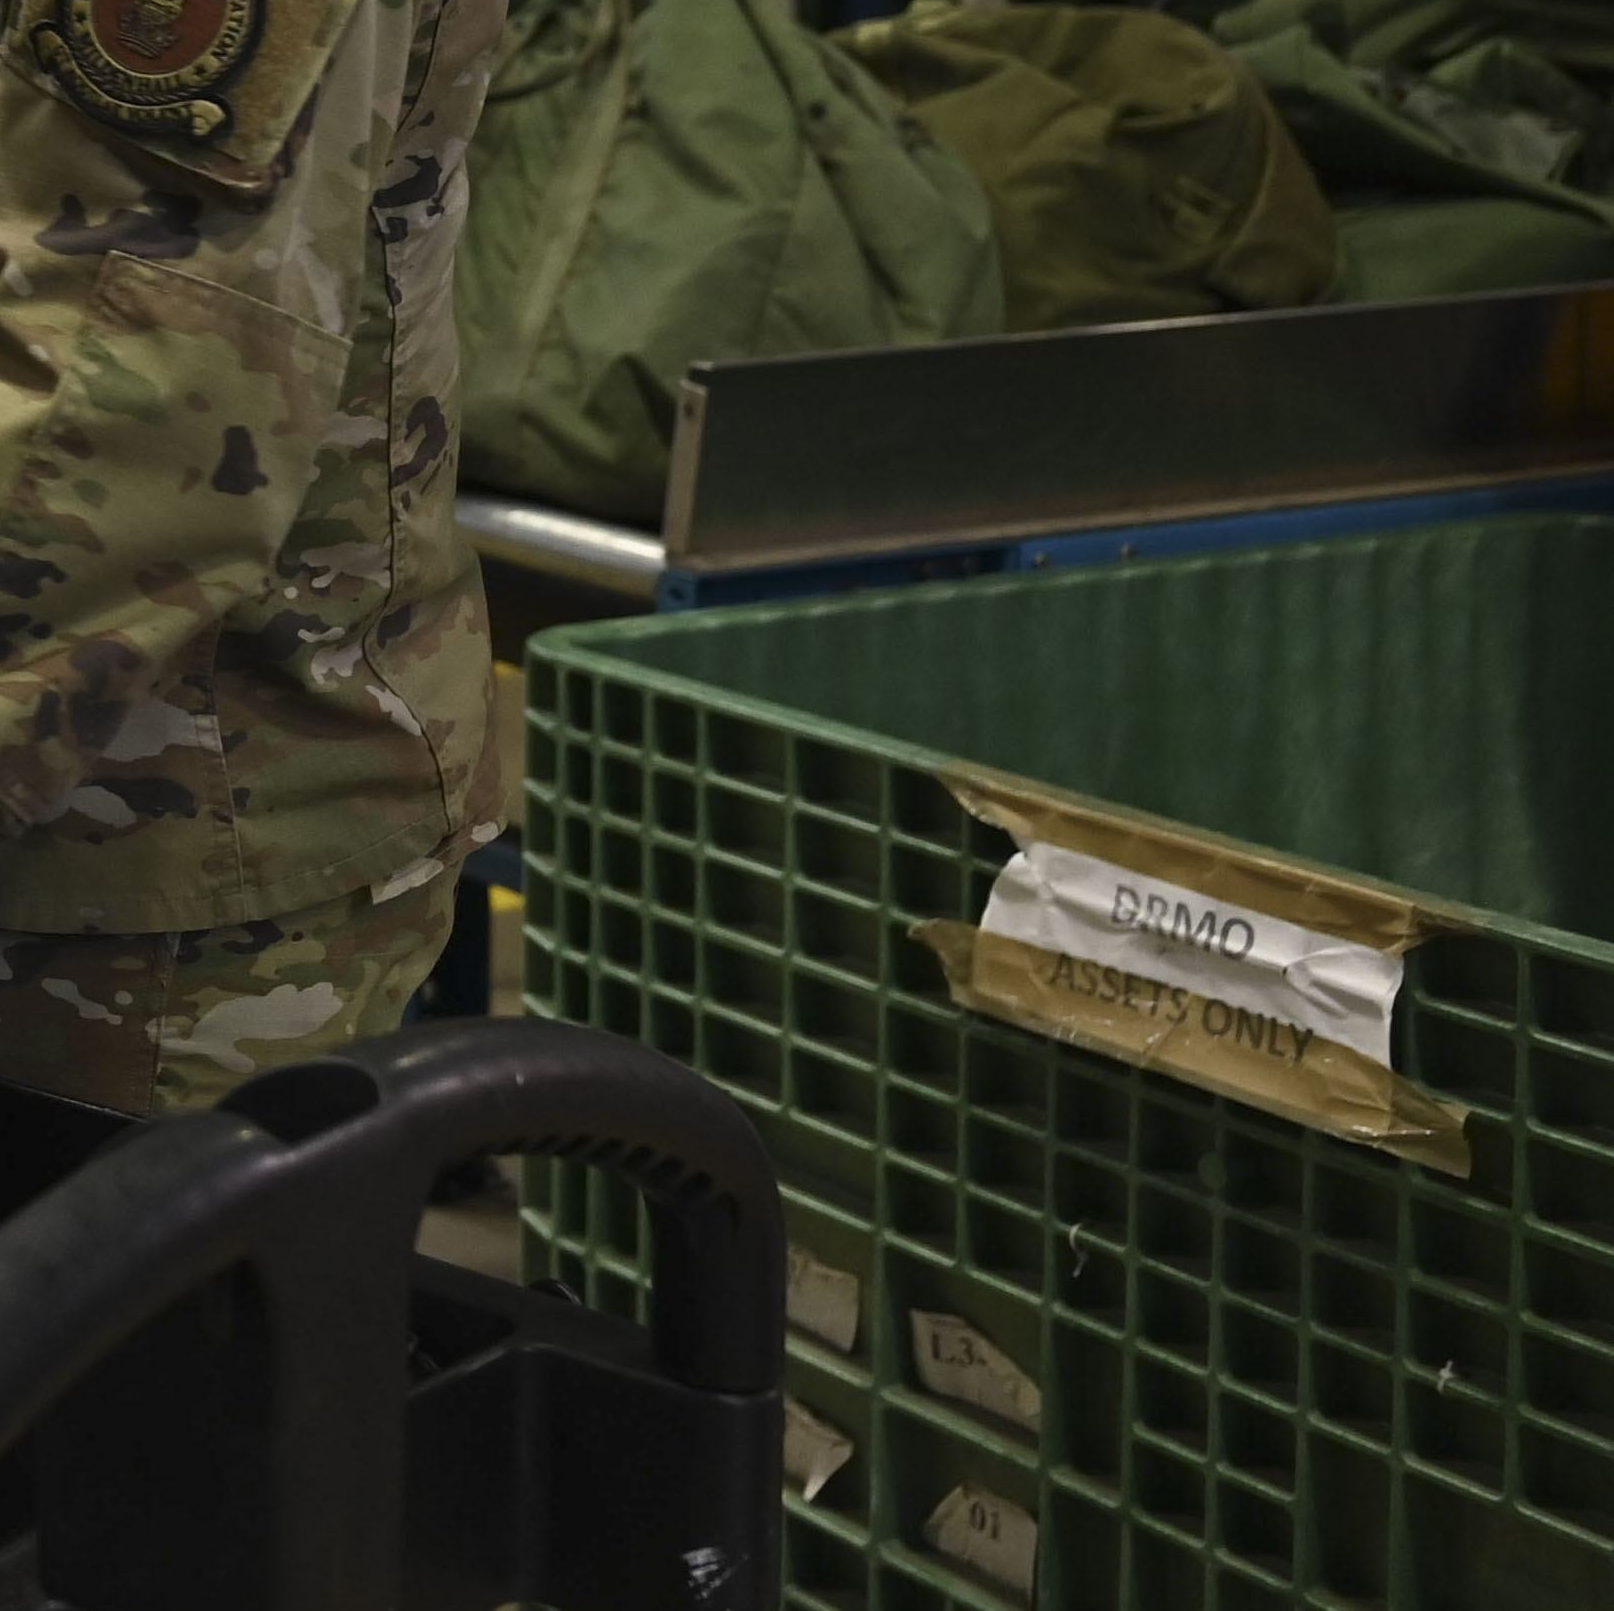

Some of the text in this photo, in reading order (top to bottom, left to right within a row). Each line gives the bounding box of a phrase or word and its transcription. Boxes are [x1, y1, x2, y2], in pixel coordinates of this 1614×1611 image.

[1109, 883, 1256, 961] DRMO
[1048, 950, 1316, 1063] ASSETS ONLY
